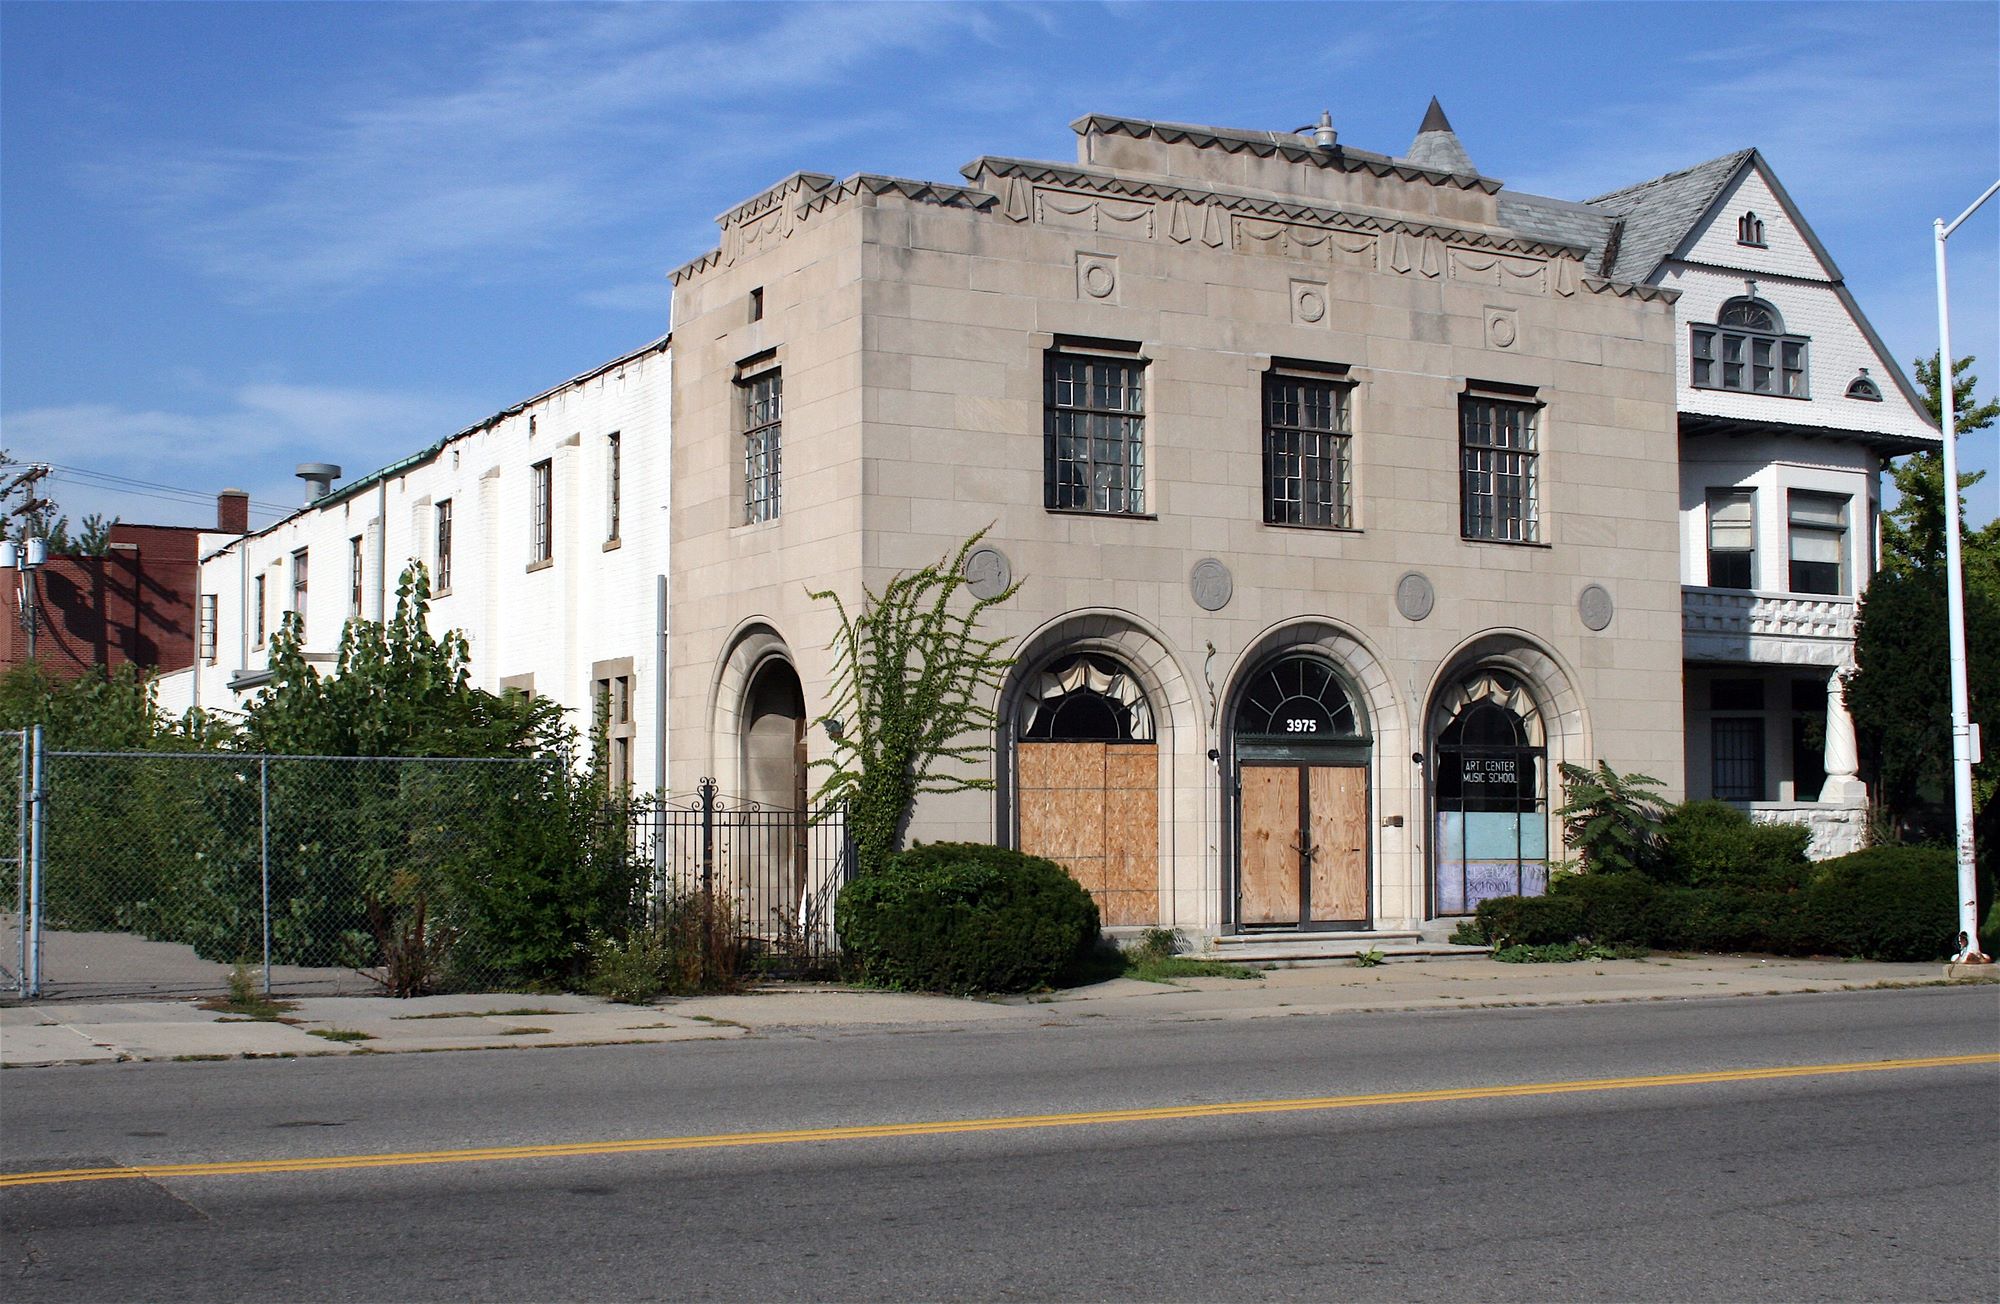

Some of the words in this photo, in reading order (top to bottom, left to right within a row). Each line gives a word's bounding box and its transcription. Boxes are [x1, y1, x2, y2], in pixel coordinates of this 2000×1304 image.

[1286, 719, 1317, 732] 3975
[1465, 760, 1480, 771] ART
[1485, 760, 1515, 771] CENTER
[1463, 772, 1486, 783] MUSIC
[1488, 772, 1518, 783] SCHOOL
